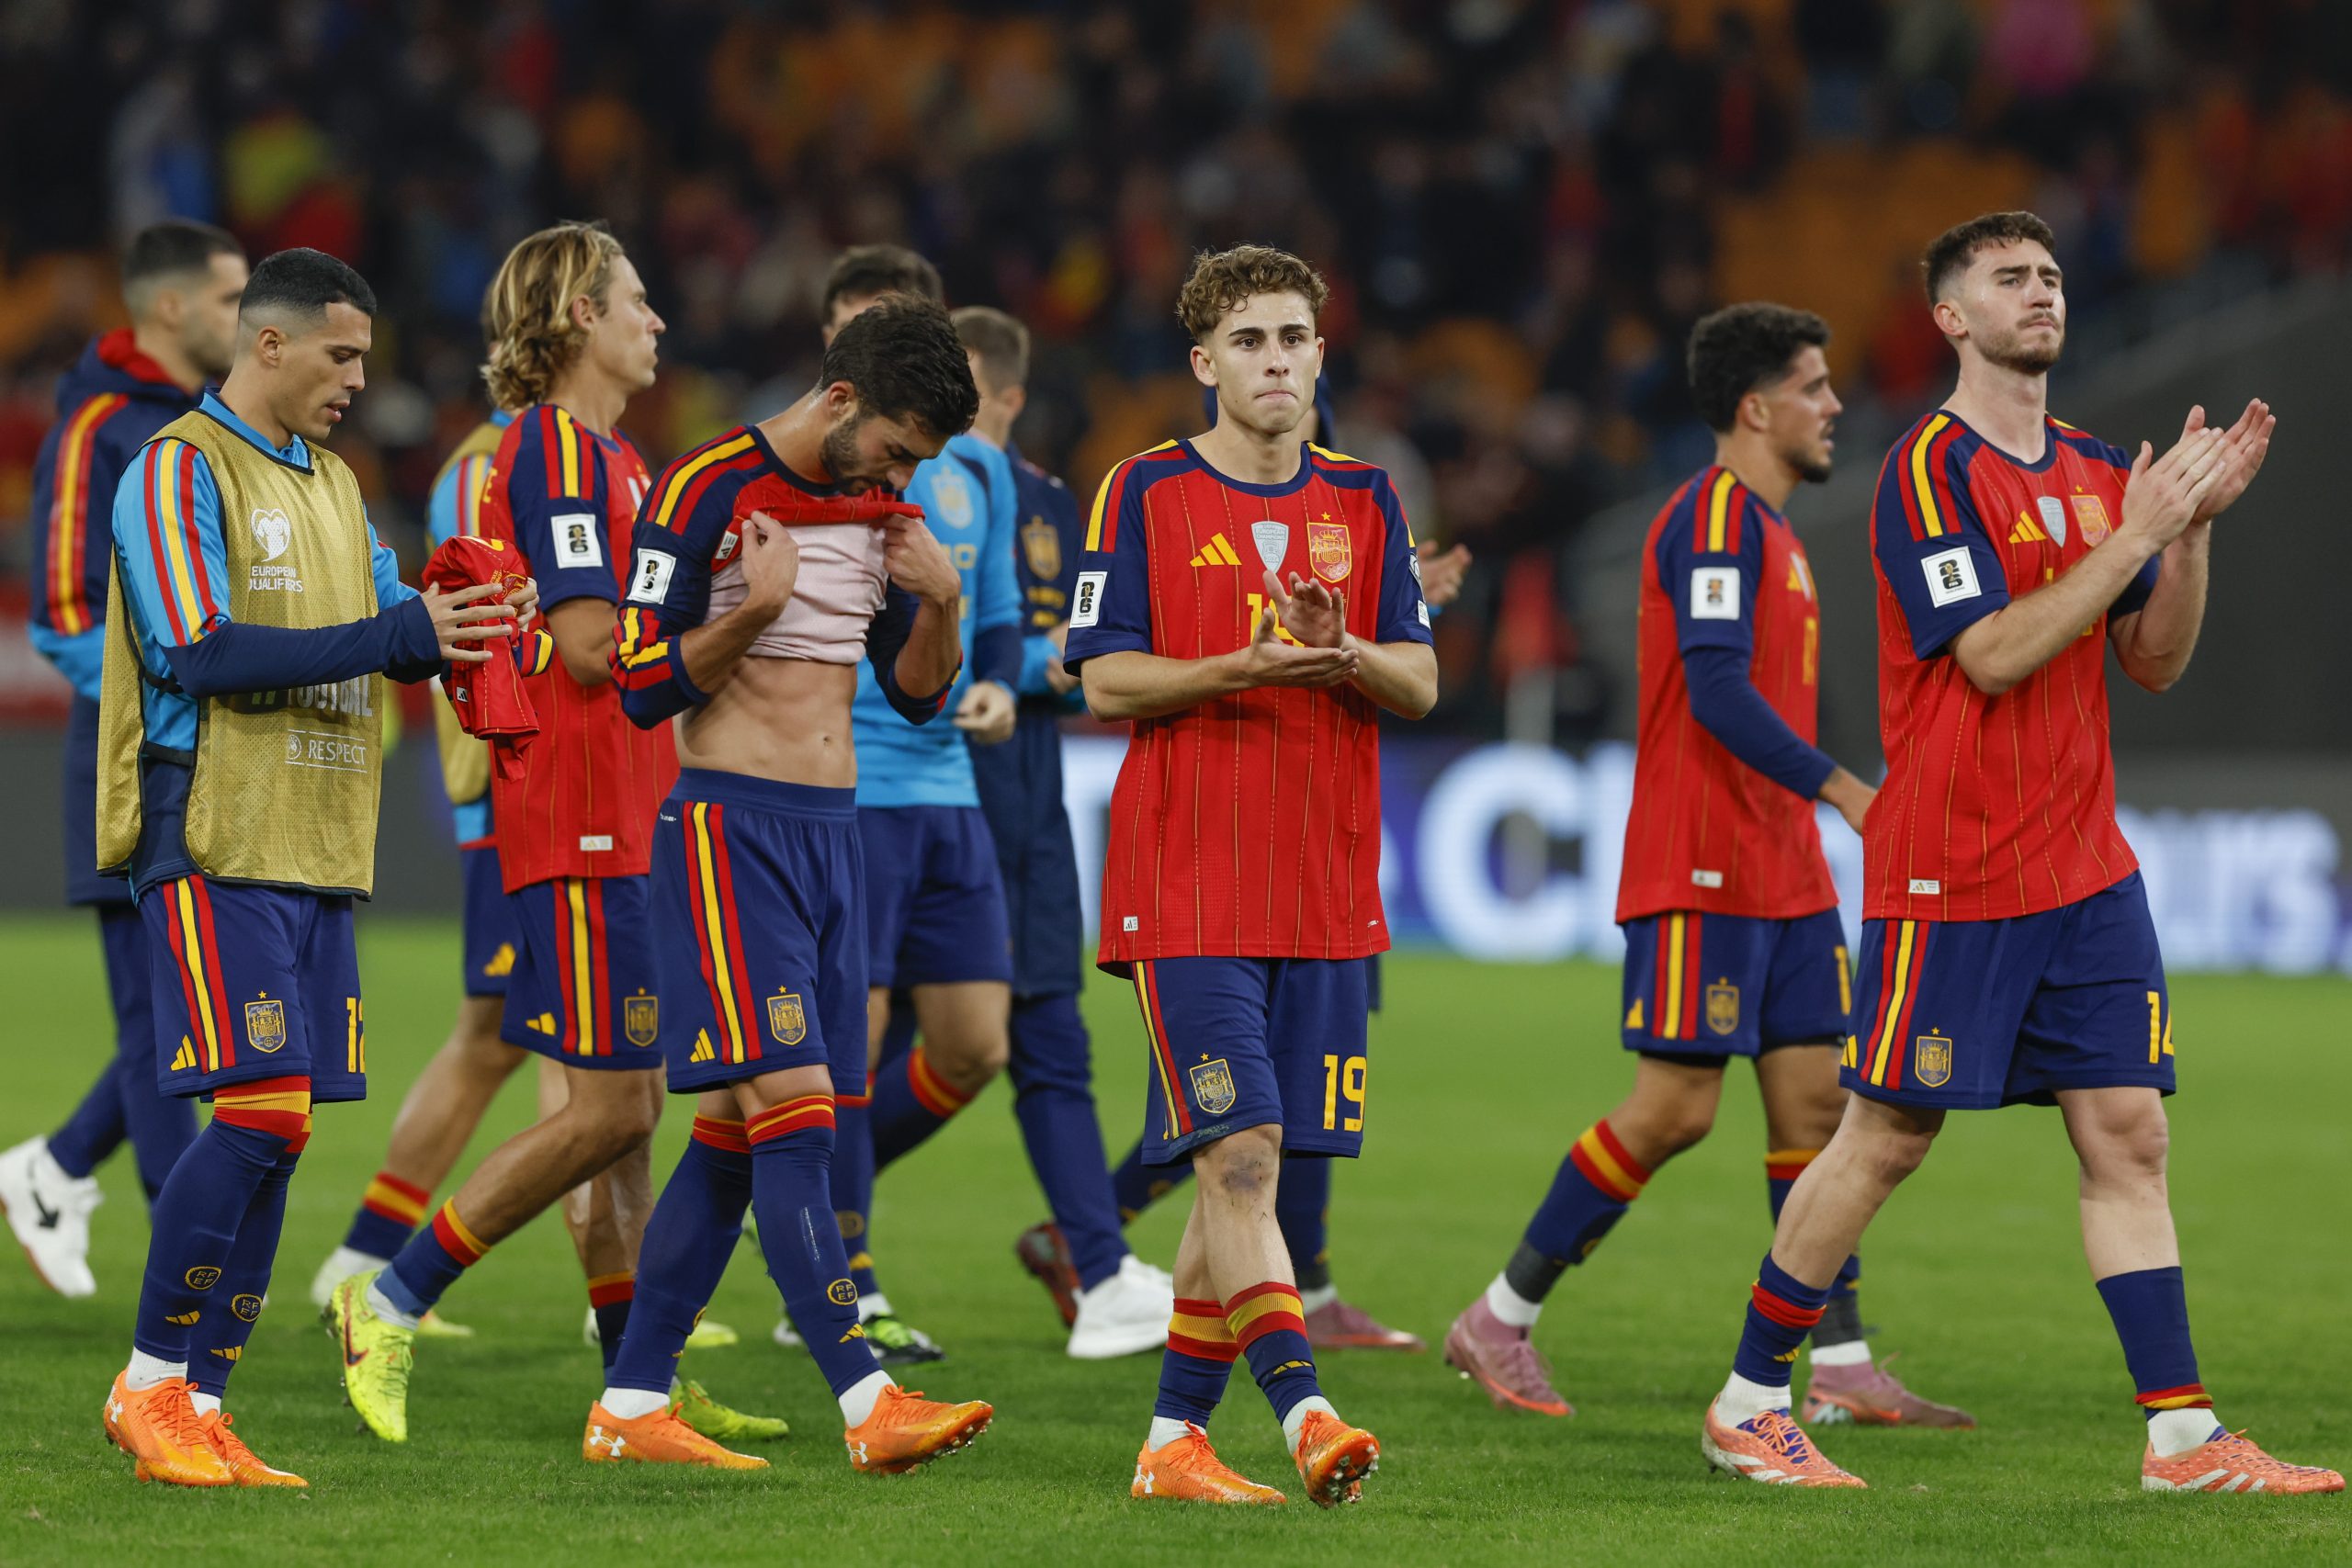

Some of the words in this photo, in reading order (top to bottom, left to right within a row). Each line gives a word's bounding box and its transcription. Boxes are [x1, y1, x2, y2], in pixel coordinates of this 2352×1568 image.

[308, 739, 367, 765] RESPECT
[346, 998, 366, 1073] 1
[1323, 1055, 1367, 1132] 19
